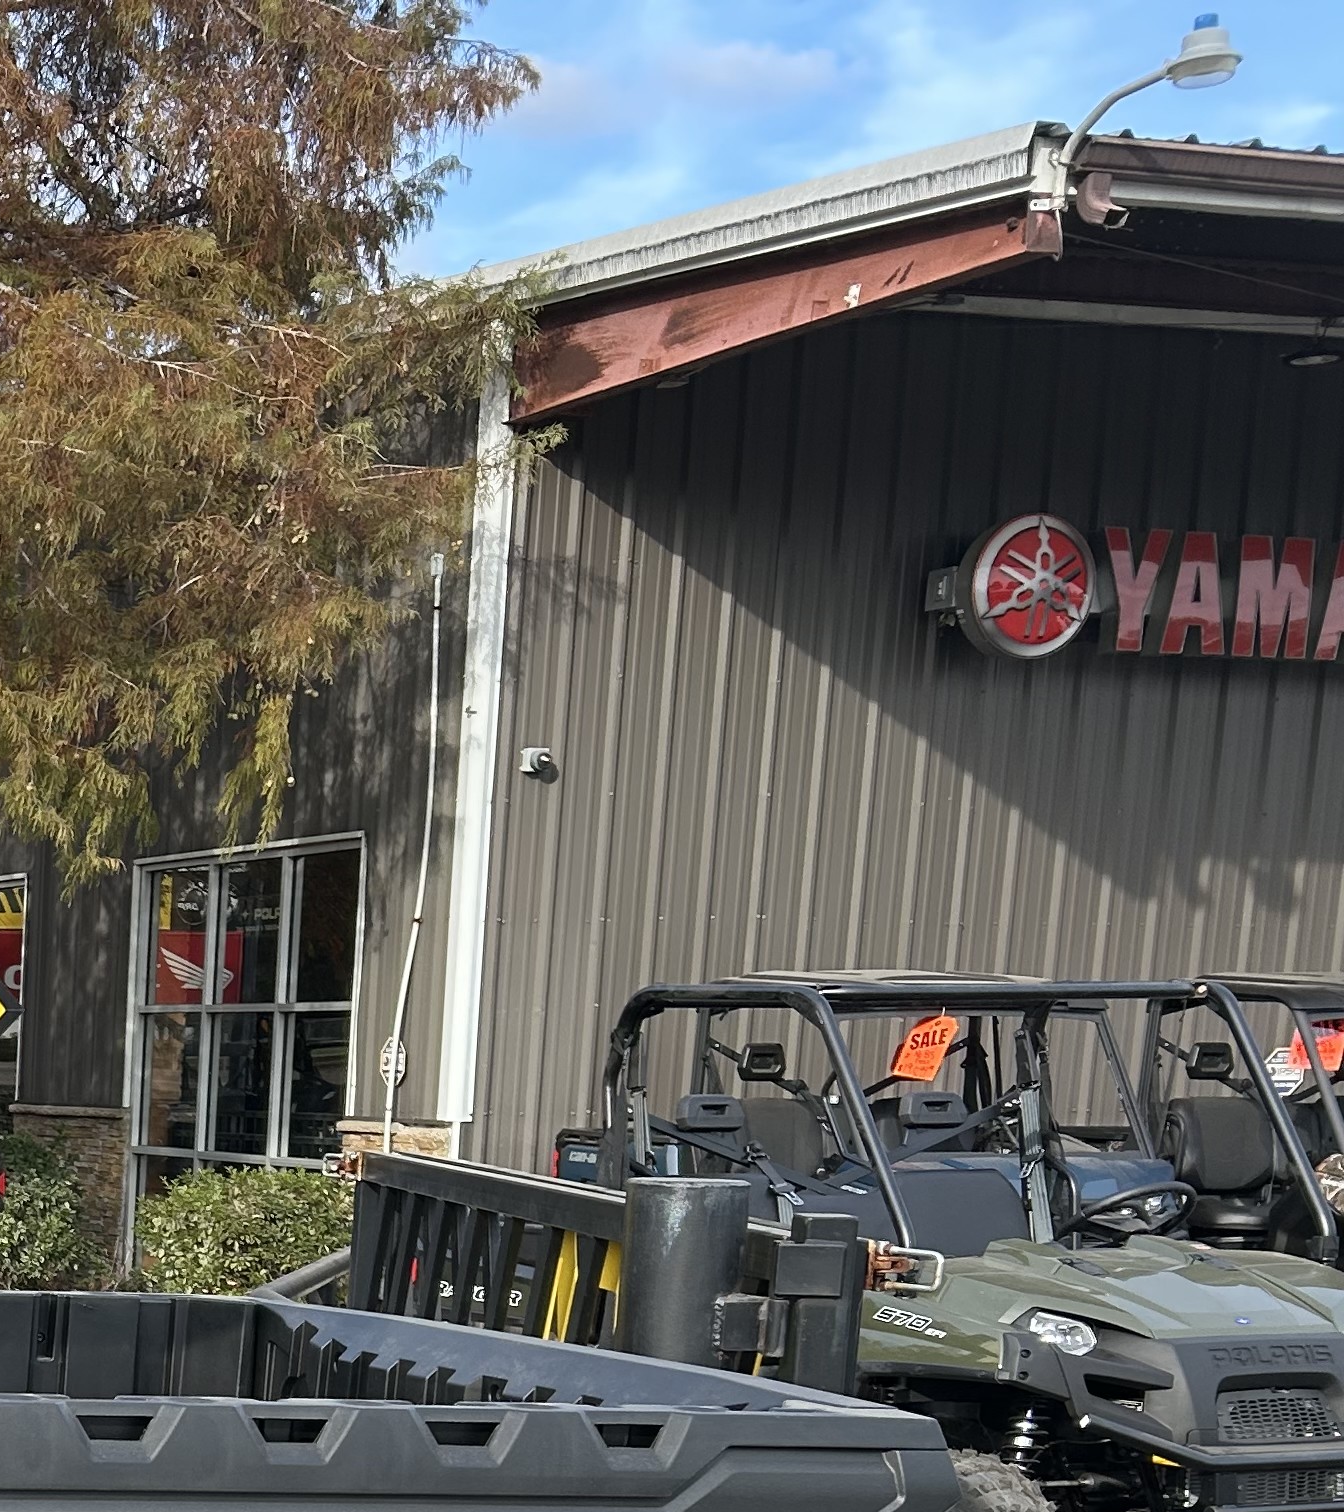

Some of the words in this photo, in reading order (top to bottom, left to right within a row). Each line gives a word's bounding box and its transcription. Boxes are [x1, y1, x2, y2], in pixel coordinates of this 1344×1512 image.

[909, 1027, 949, 1050] SALE
[872, 1305, 933, 1331] 570
[1208, 1344, 1334, 1367] POLARIS
